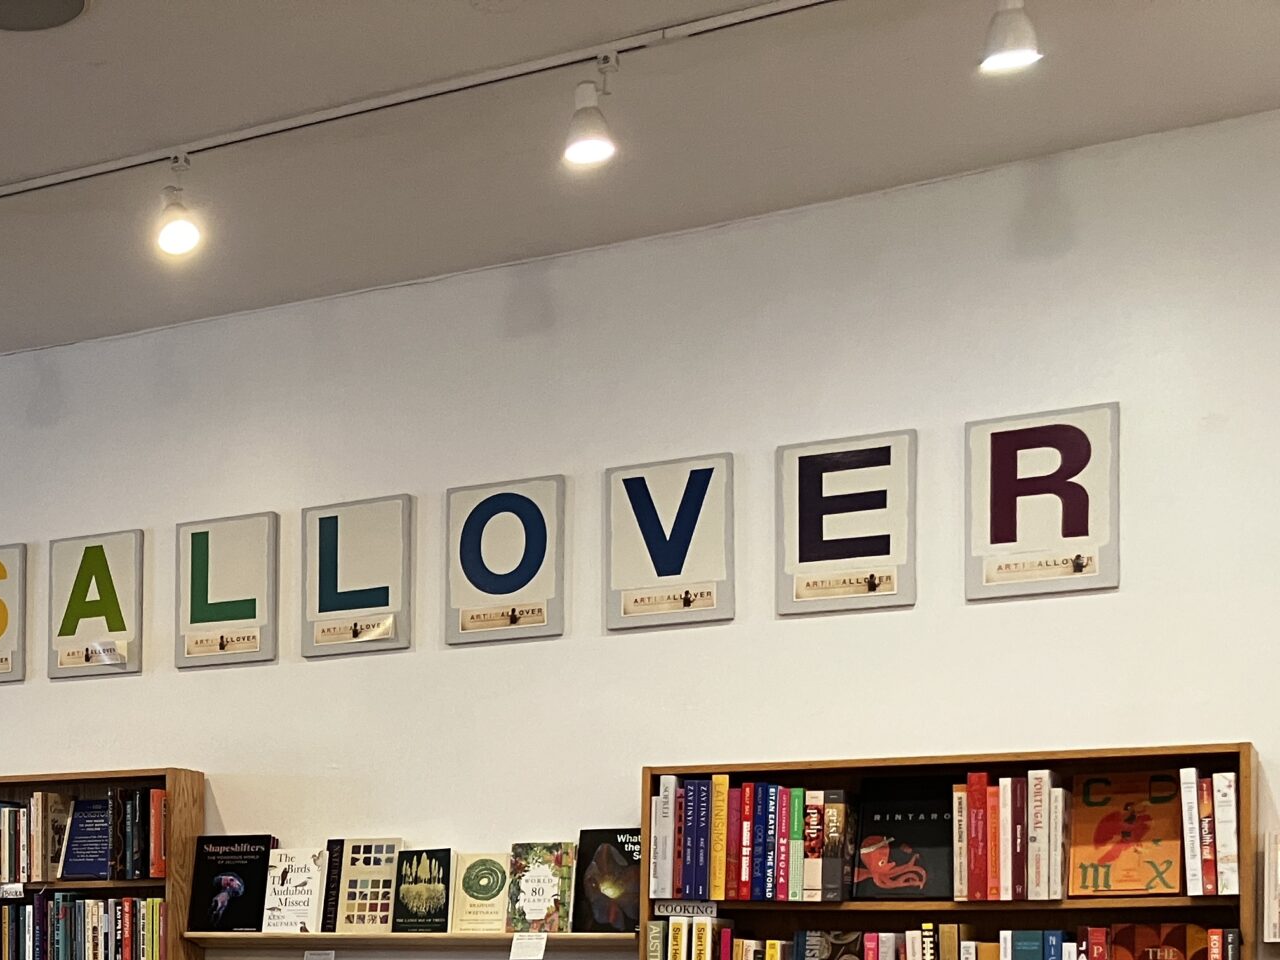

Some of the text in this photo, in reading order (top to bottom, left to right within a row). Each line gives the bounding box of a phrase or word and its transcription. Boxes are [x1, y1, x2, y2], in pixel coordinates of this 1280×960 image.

[1034, 776, 1043, 832] PORTUGAL
[873, 812, 951, 821] RINTARO
[806, 809, 821, 837] pulp
[826, 808, 839, 837] grist
[617, 835, 641, 843] What
[204, 844, 265, 854] Shapeshifters
[278, 854, 295, 862] The
[287, 865, 310, 873] Birds
[270, 888, 312, 896] Audubon
[531, 887, 545, 896] 80
[278, 898, 309, 907] Missed
[657, 903, 714, 915] COOKING
[673, 926, 681, 949] Start
[696, 926, 704, 948] Start
[1145, 948, 1177, 960] THE
